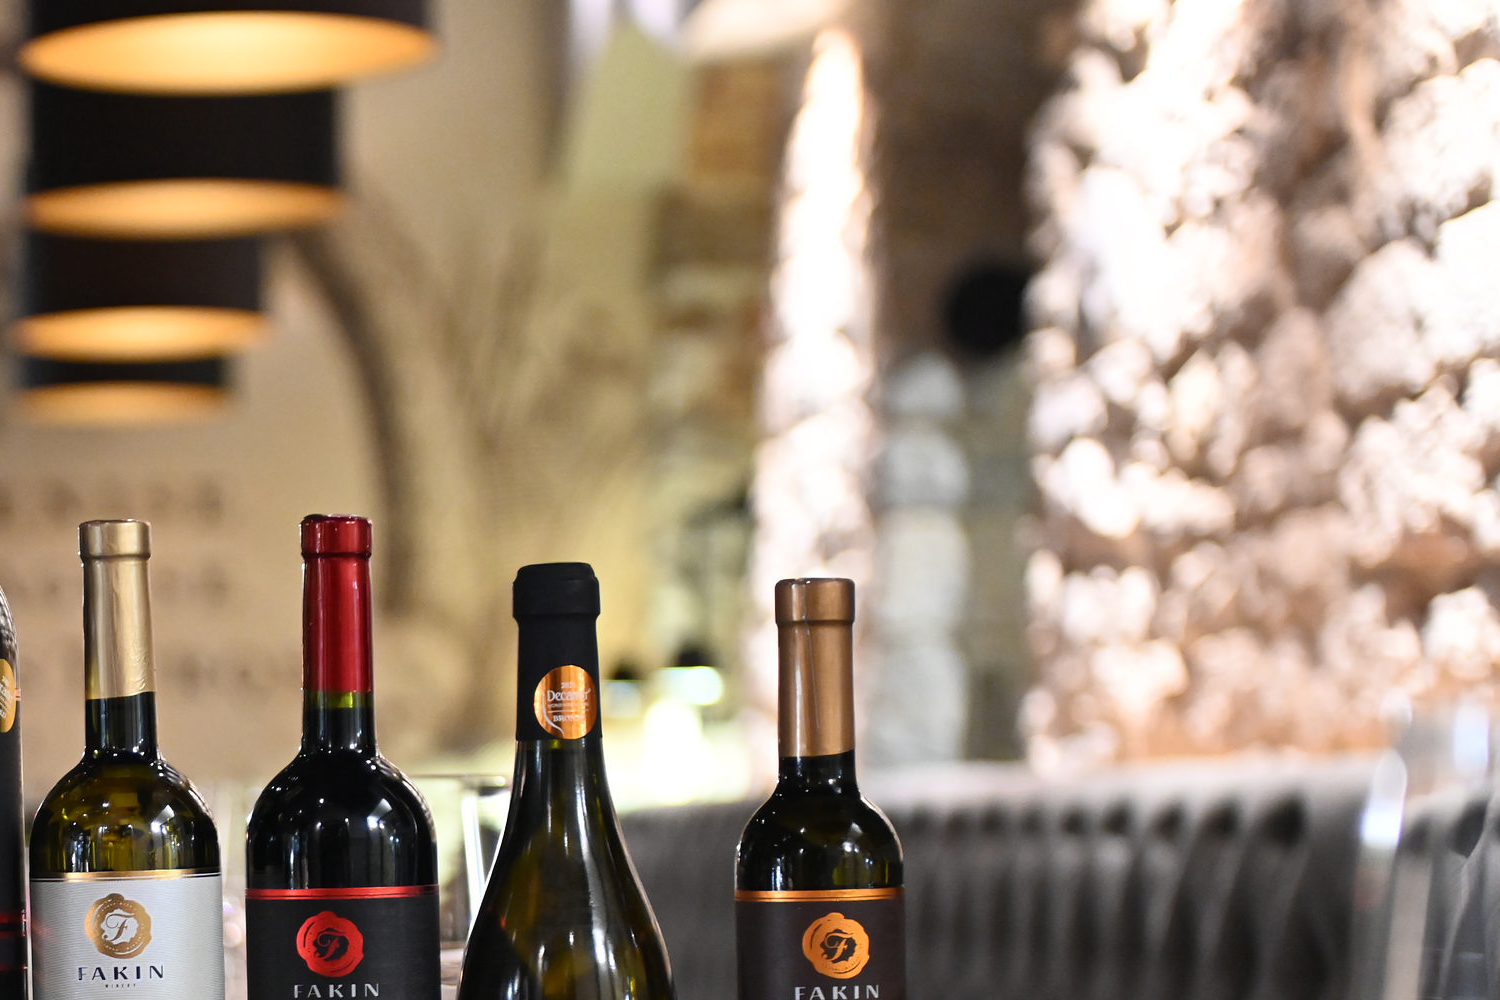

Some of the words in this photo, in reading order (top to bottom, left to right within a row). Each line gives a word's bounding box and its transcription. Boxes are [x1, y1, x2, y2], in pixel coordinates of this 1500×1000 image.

[77, 965, 164, 981] FAKIN
[293, 983, 379, 999] FAKIN
[794, 984, 879, 1000] FAKIN
